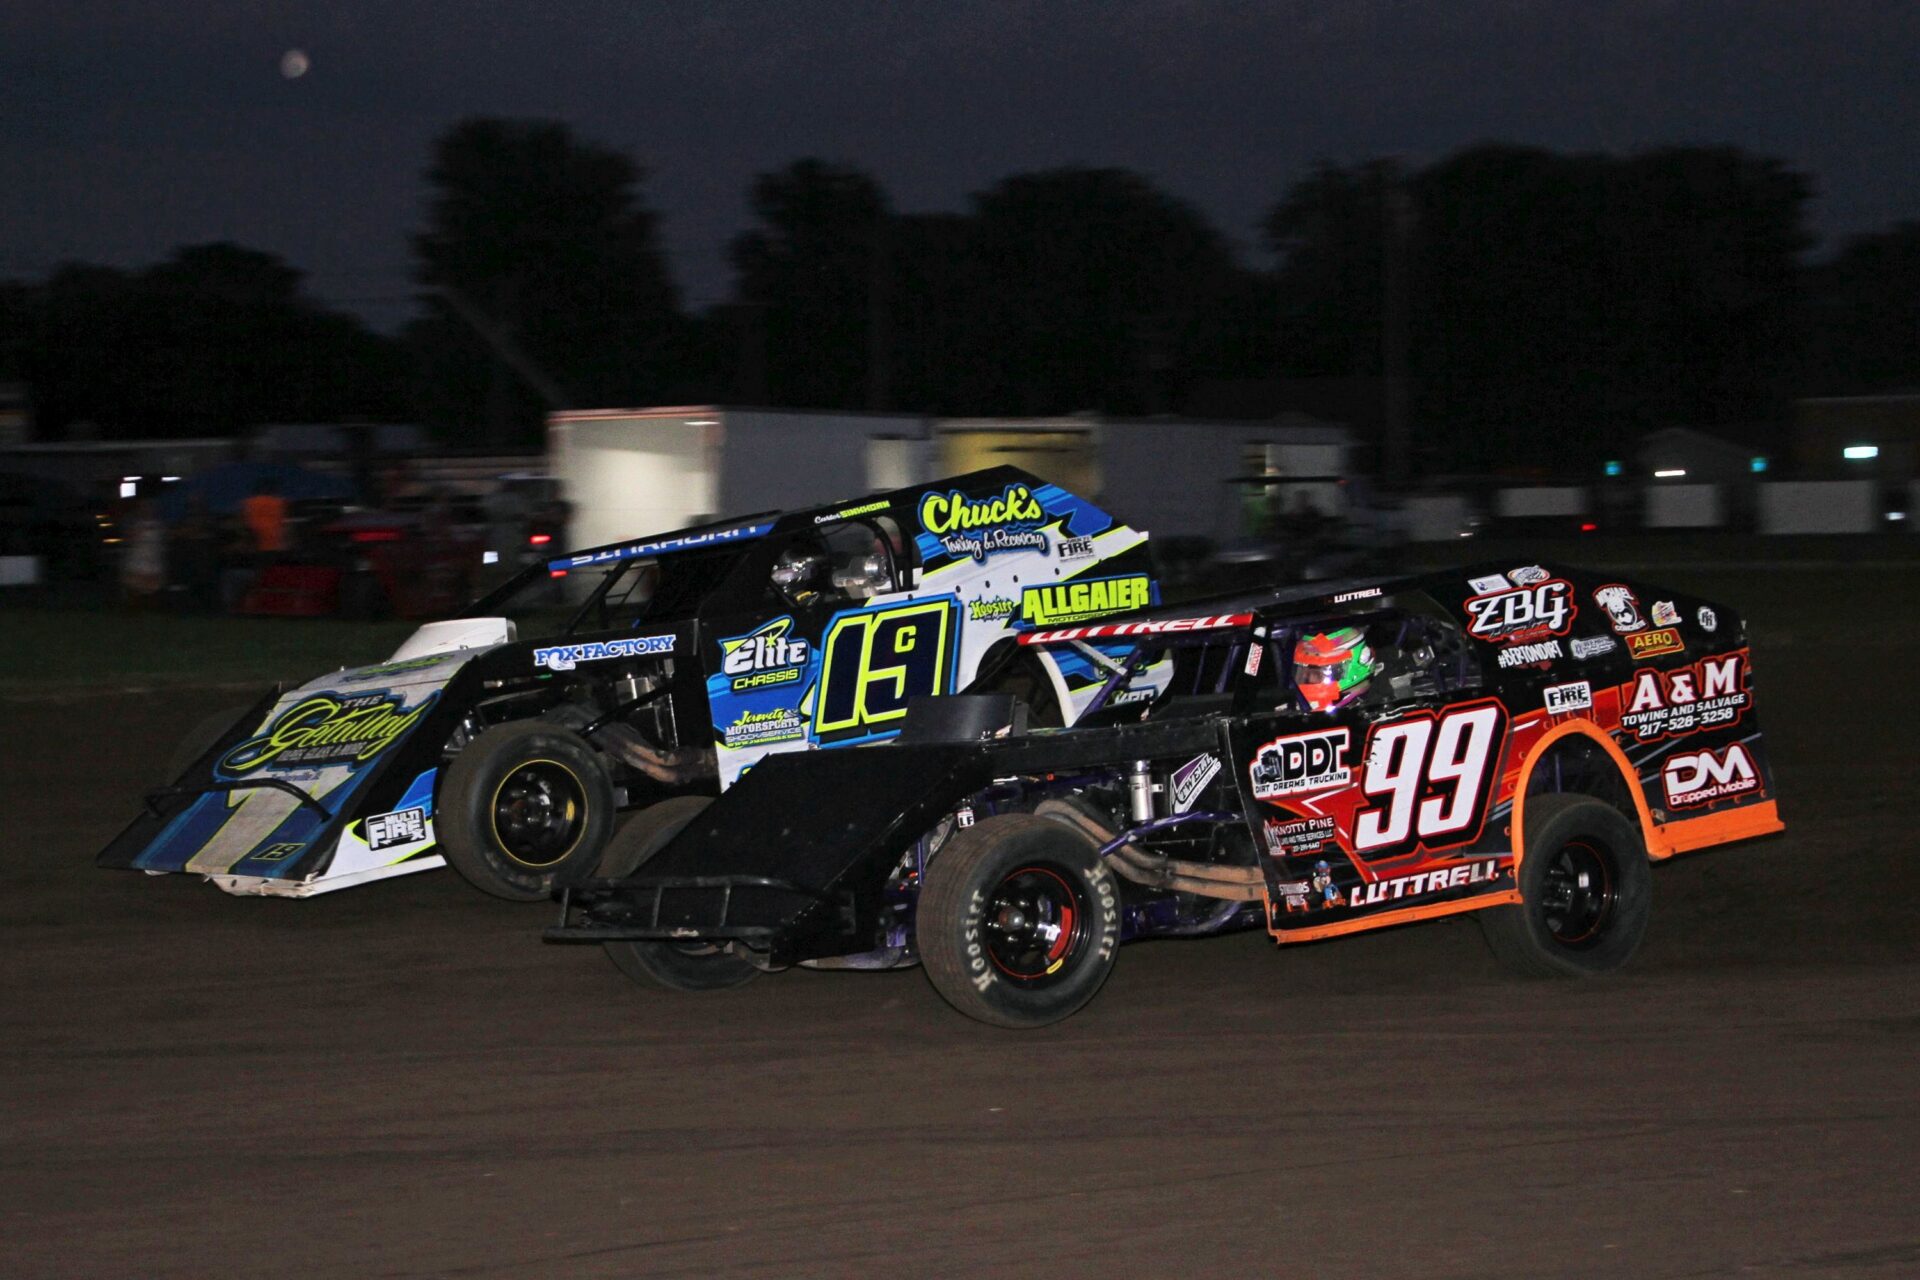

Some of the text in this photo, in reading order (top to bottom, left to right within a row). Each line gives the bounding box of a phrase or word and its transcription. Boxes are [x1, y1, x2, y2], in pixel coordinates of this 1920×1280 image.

[922, 486, 1042, 534] Chuck's
[1022, 576, 1150, 626] ALLGAIER
[1334, 587, 1382, 603] LUTTRELL
[894, 625, 917, 654] C
[1027, 614, 1236, 645] LUTTRELL
[1634, 632, 1673, 648] AERO
[581, 634, 676, 661] FACTORY
[723, 633, 808, 675] Elite
[732, 668, 799, 690] CHASSIS
[815, 602, 950, 734] 19
[1548, 688, 1587, 707] FIRE
[1629, 657, 1739, 713] A & M
[344, 695, 383, 709] THE
[1622, 693, 1745, 727] TOWING AND SALVAGE
[726, 717, 800, 736] MOTORSPORTS
[1639, 707, 1734, 737] 217-528-3258
[1280, 733, 1346, 781] DDT
[1255, 771, 1348, 794] DIRT DREAMS TRUCKING
[1355, 706, 1498, 850] 99
[1669, 778, 1757, 806] Dropped Mobile
[384, 810, 420, 827] MULTI
[959, 814, 974, 827] LF
[1272, 817, 1334, 836] KNOTTY PINE
[370, 820, 421, 850] FIRE
[1350, 860, 1499, 907] LUTTRELL
